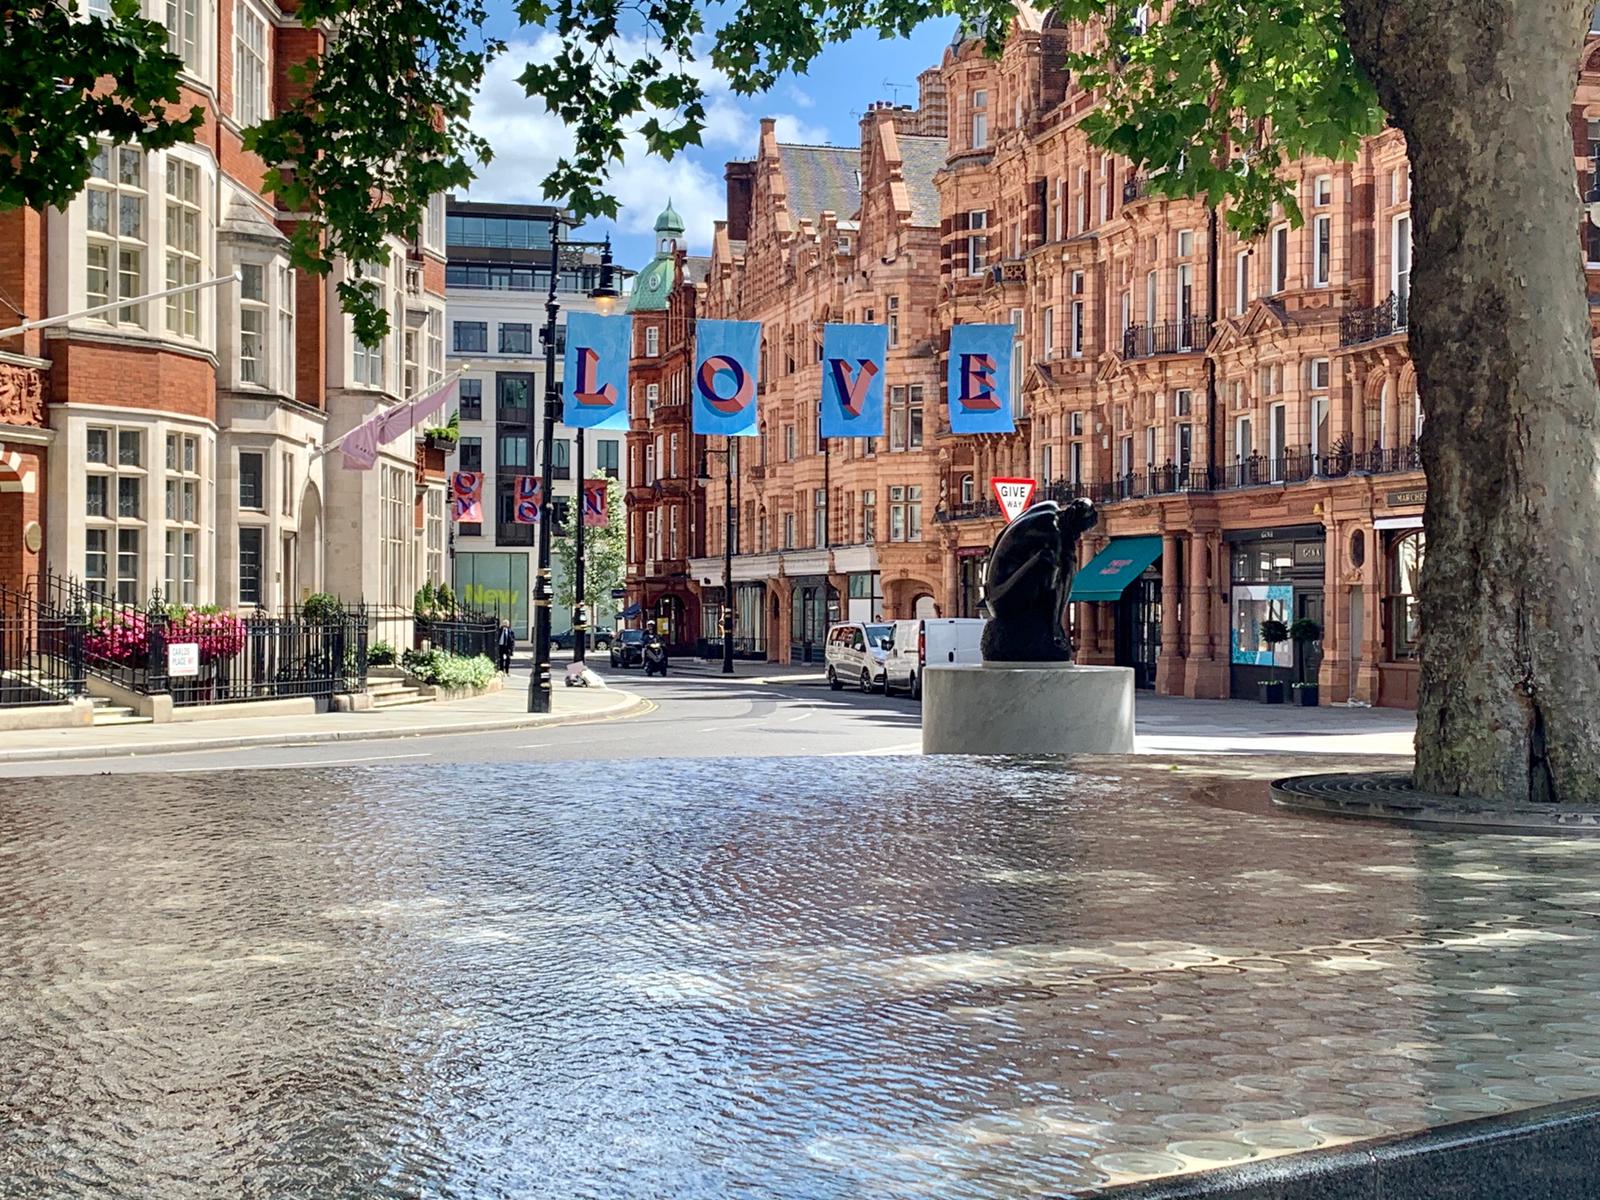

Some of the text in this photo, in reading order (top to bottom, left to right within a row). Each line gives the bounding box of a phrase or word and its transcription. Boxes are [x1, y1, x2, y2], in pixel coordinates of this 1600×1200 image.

[1001, 485, 1026, 497] GIVE
[1007, 500, 1022, 508] WAY
[464, 584, 519, 605] New
